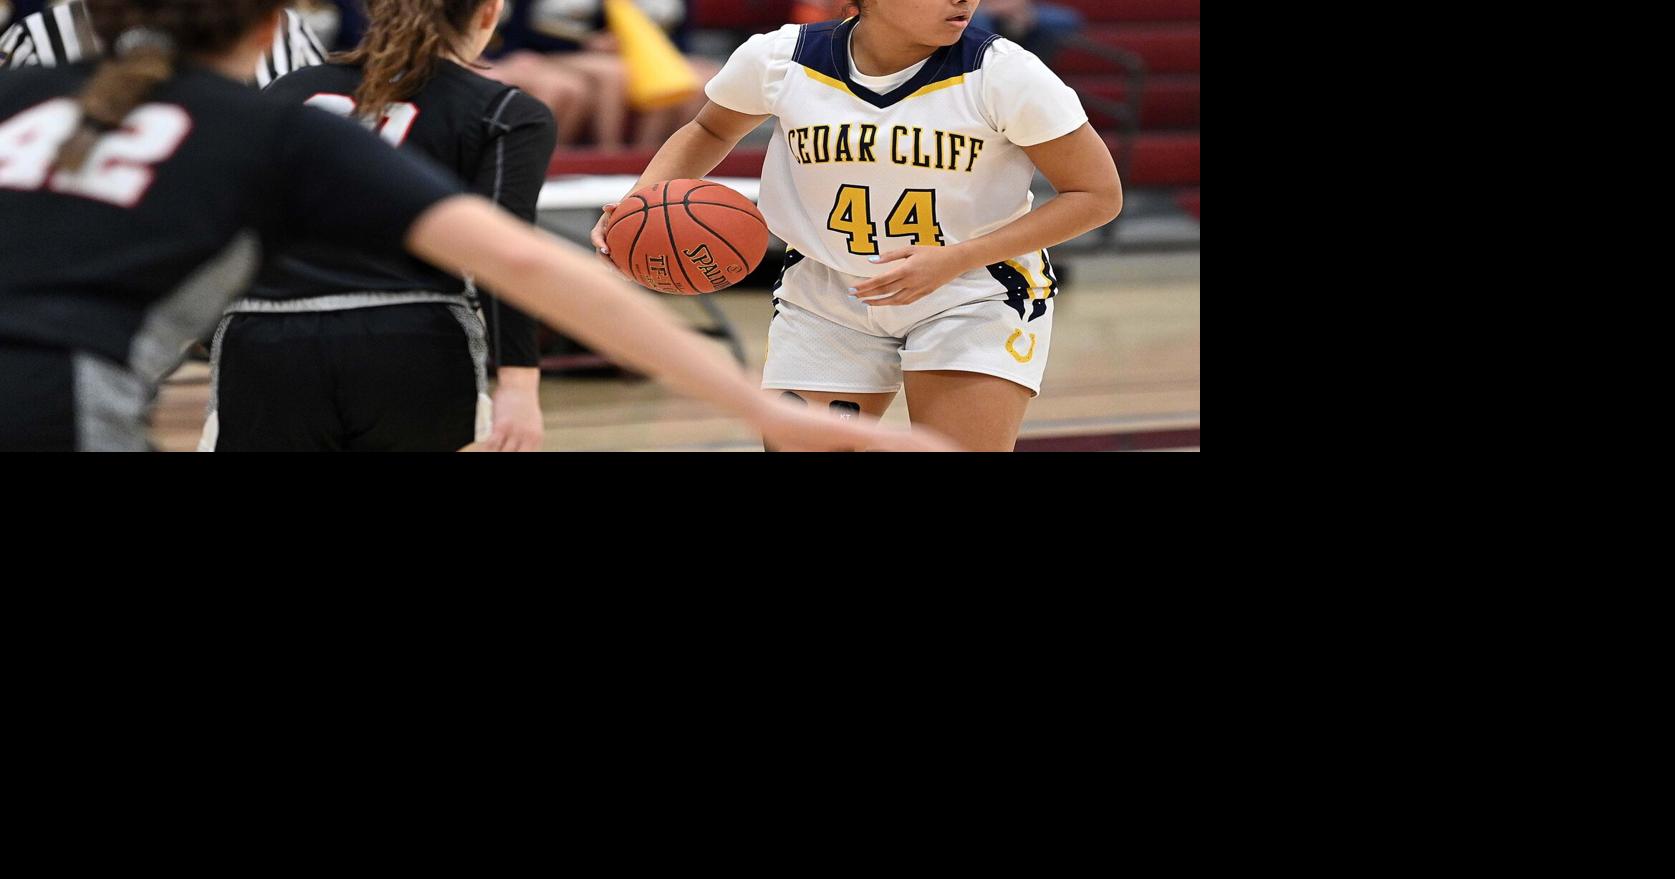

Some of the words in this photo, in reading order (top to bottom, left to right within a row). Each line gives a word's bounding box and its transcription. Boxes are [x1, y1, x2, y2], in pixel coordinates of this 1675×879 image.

[0, 97, 194, 208] 42
[787, 123, 877, 165] CEDAR
[890, 124, 985, 172] CLIFF
[826, 183, 945, 256] 44
